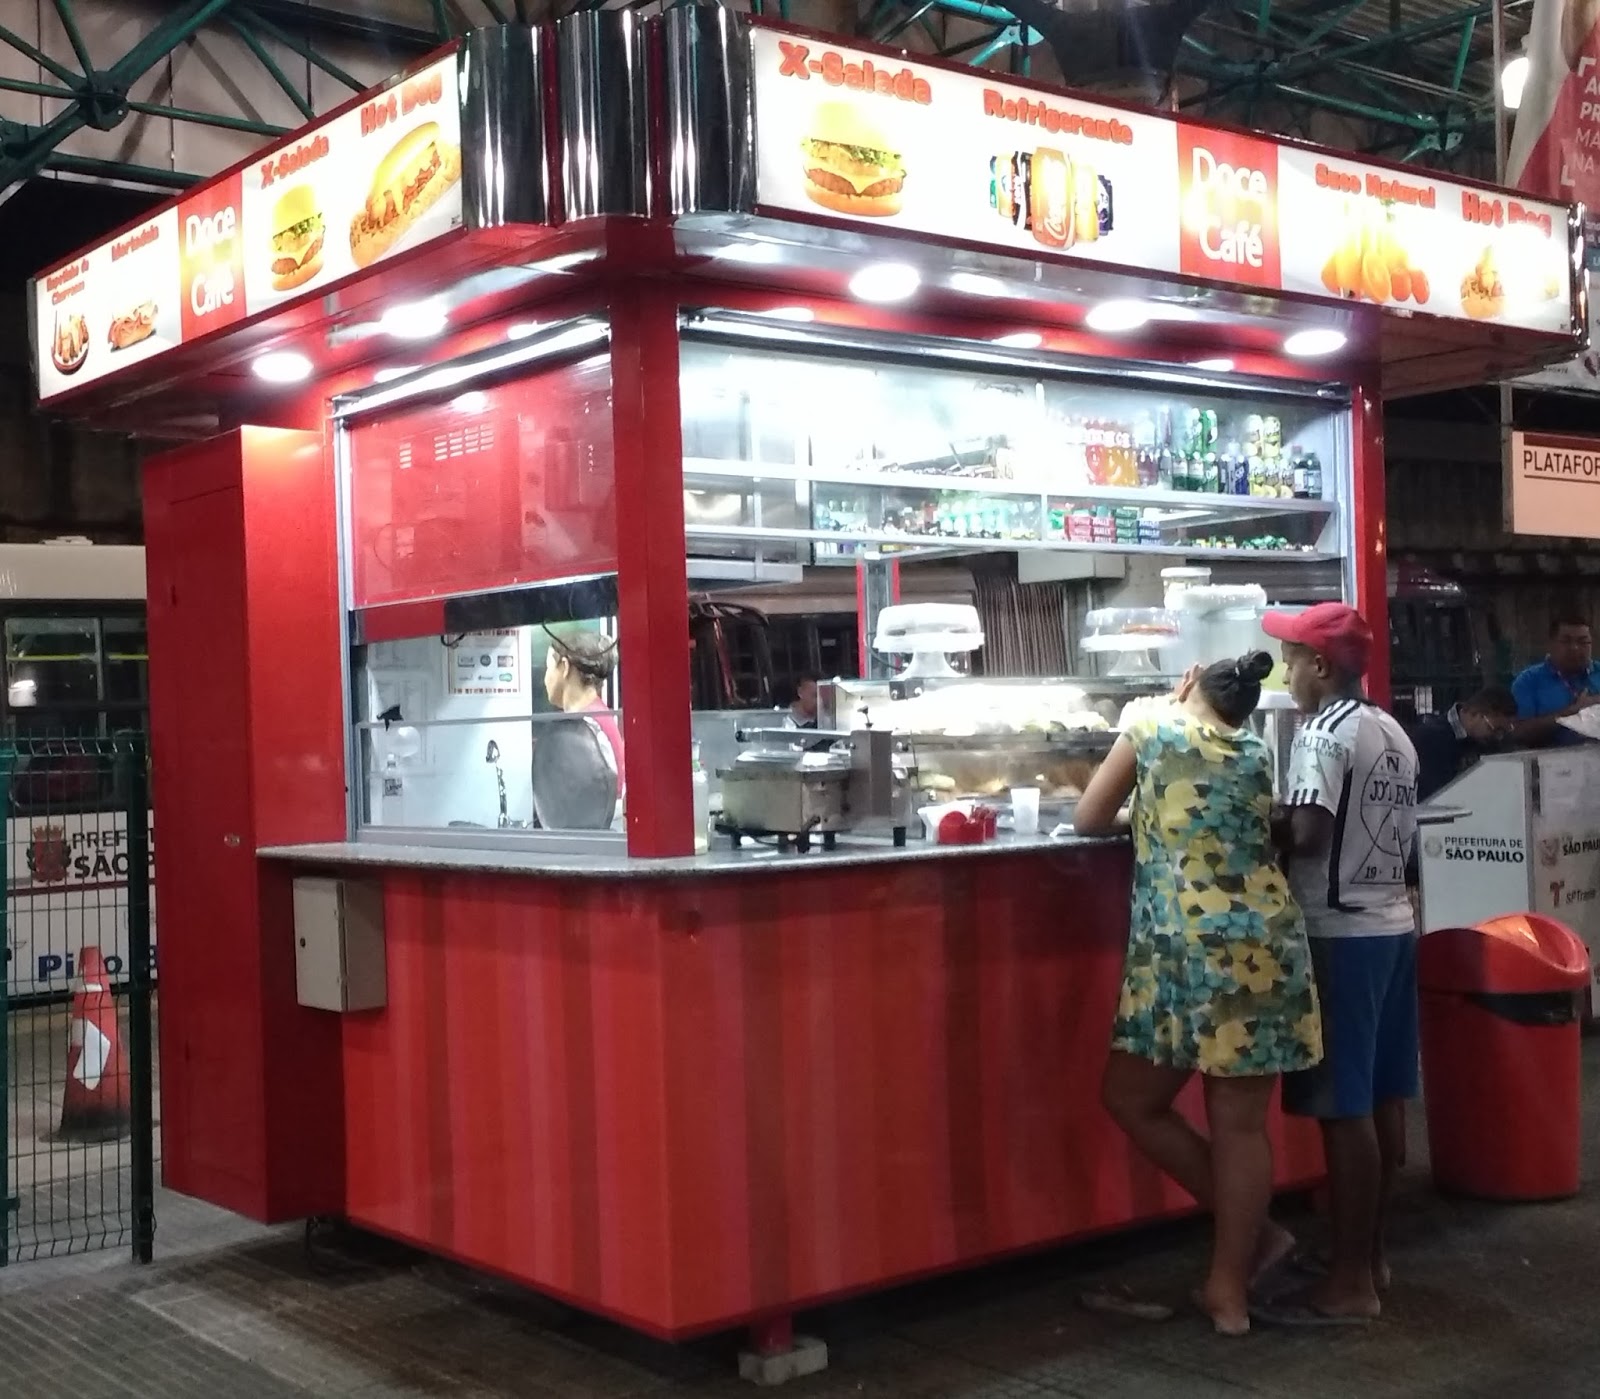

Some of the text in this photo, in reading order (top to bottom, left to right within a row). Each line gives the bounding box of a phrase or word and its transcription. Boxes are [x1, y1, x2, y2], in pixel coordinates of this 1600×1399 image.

[778, 41, 933, 105] X-Salada
[361, 94, 398, 137] Hot
[983, 89, 1133, 146] Refrigerante
[261, 135, 330, 189] X-Salada
[1193, 147, 1268, 200] Doce
[1315, 163, 1436, 209] Suco Natural
[186, 206, 235, 255] Doce
[1462, 190, 1504, 229] Hot
[1199, 219, 1263, 268] Café
[191, 264, 234, 316] Café
[1444, 836, 1523, 848] PREFEITURA DE
[1445, 848, 1525, 863] SÃO PAULO
